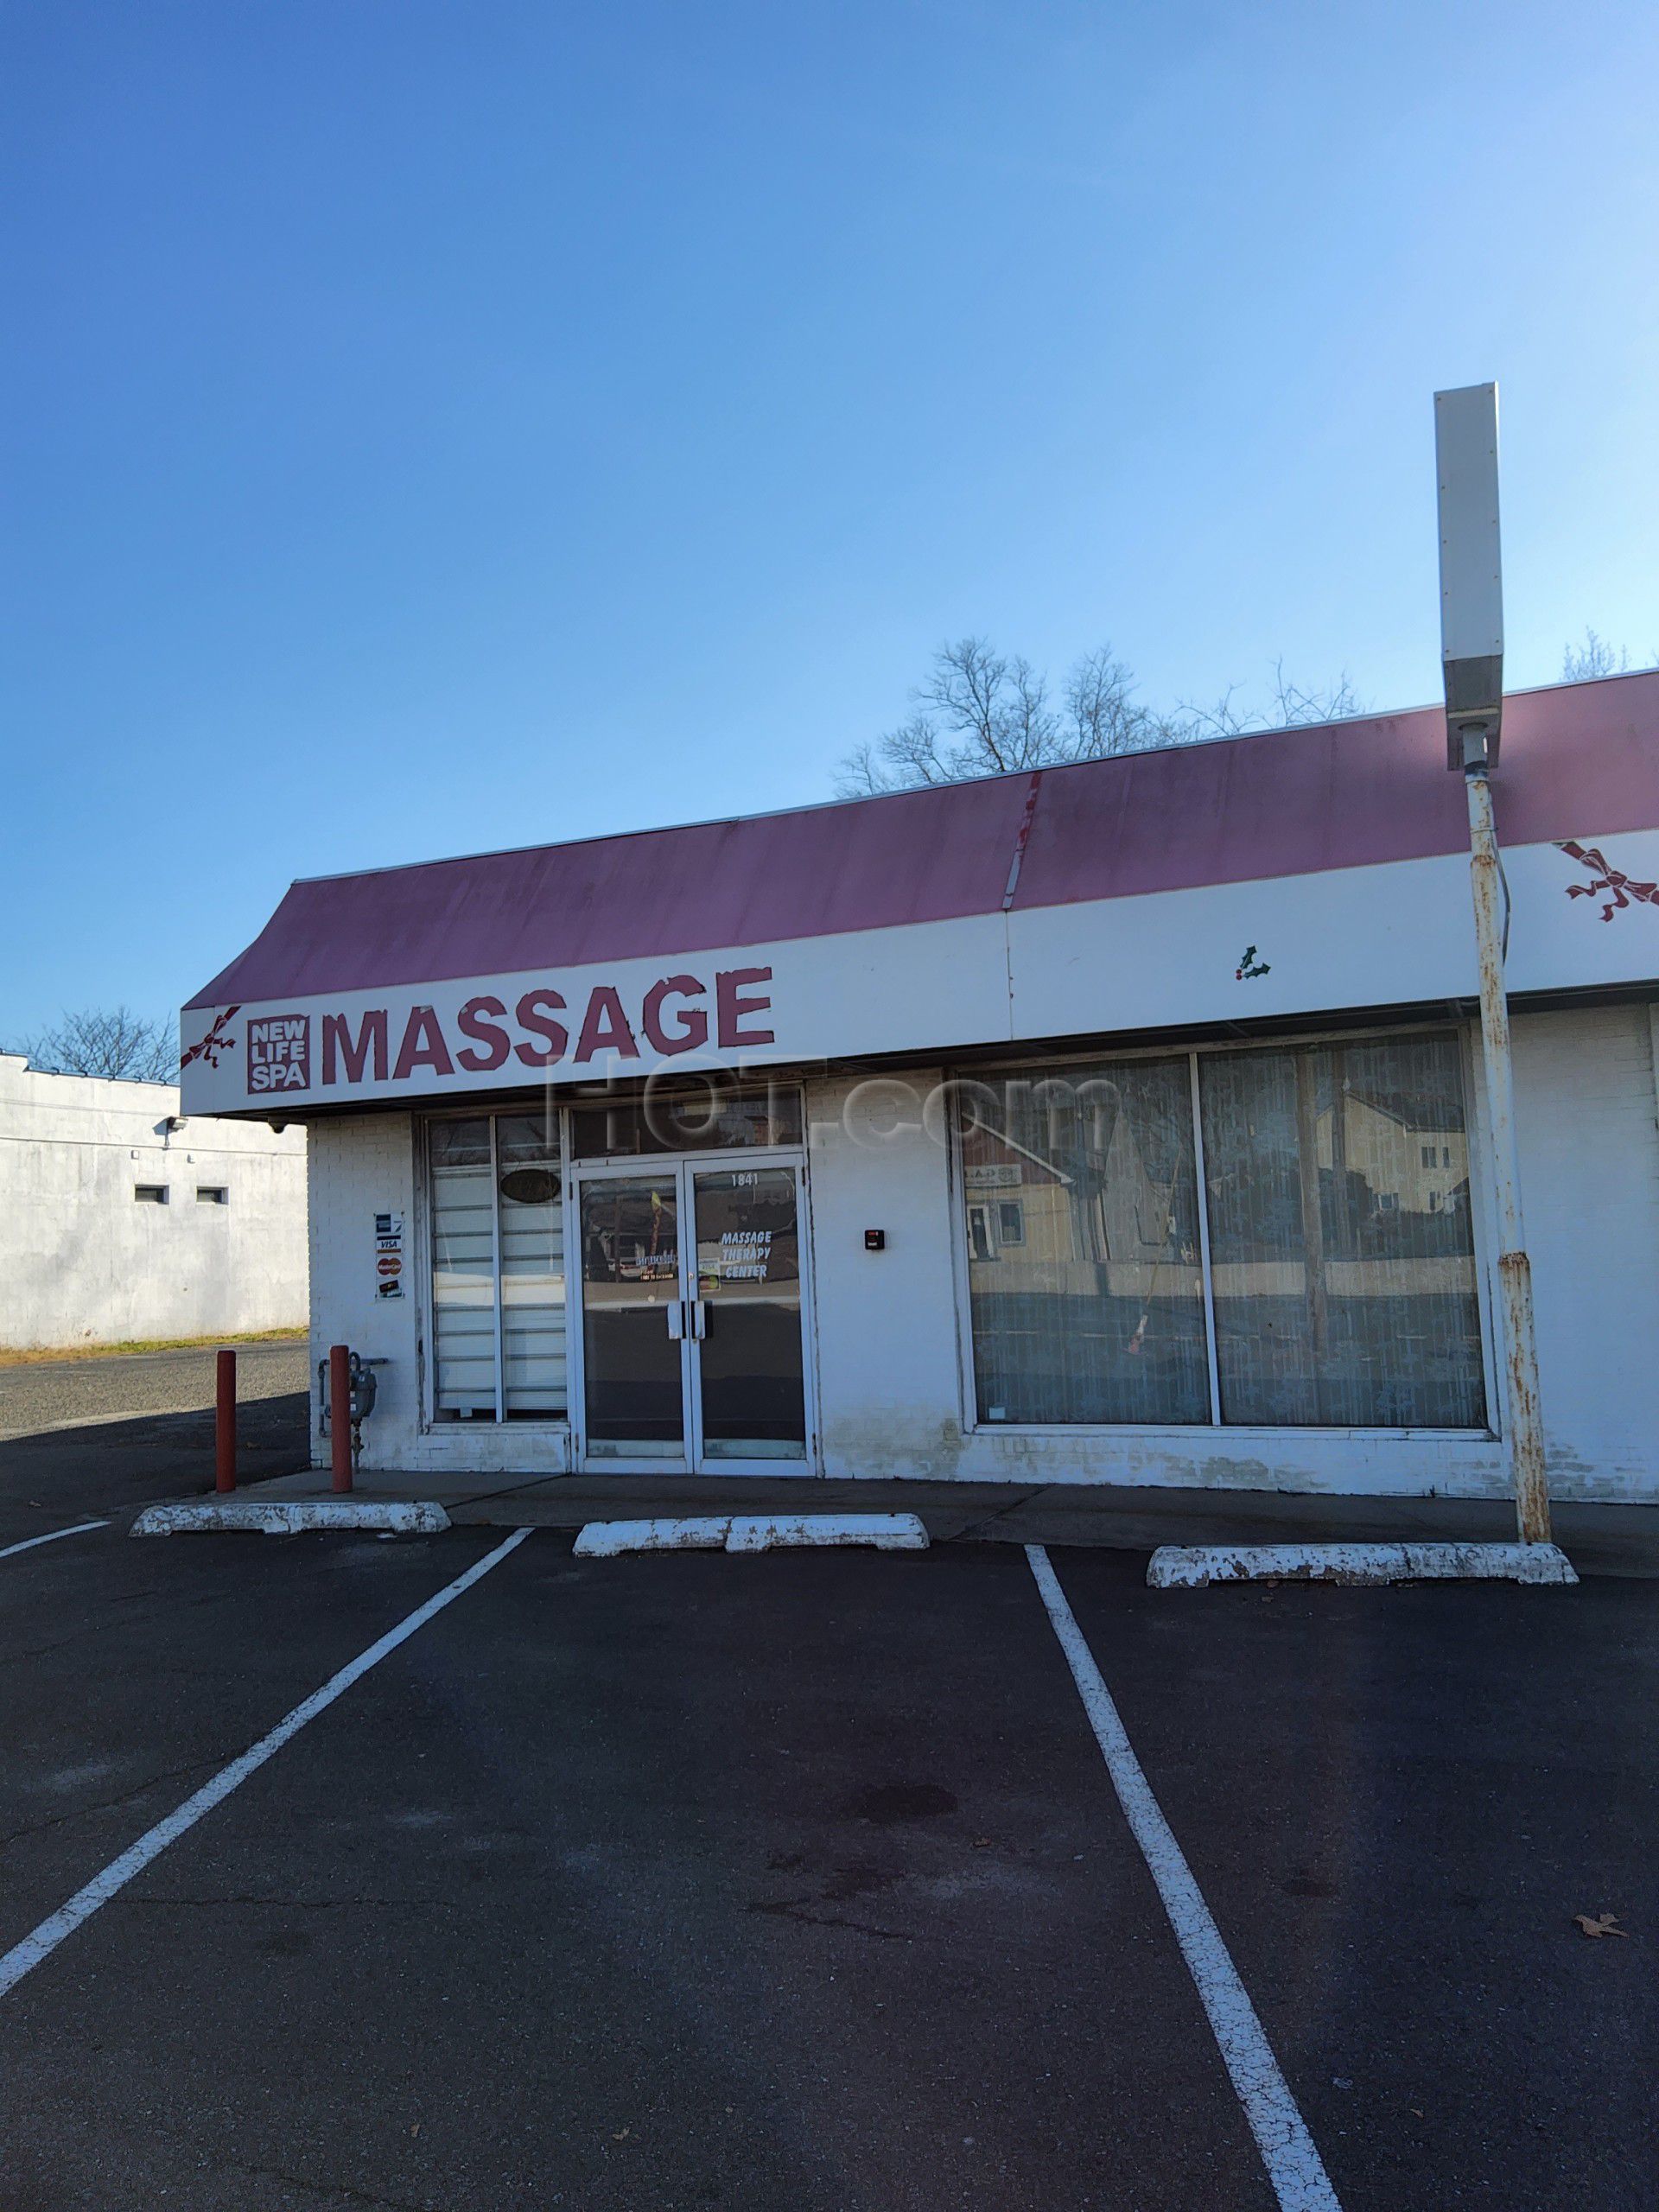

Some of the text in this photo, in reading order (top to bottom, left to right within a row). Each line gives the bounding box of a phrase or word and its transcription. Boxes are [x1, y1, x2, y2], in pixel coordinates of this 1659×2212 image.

[251, 1020, 306, 1044] NEW
[321, 967, 775, 1084] MASSAGE
[251, 1040, 306, 1065] LIFE
[251, 1061, 307, 1090] SPA
[731, 1173, 758, 1186] 1841
[381, 1240, 397, 1249] VISA
[721, 1230, 772, 1245] MASSAGE
[722, 1247, 772, 1262] THERAPY
[726, 1264, 767, 1278] CENTER
